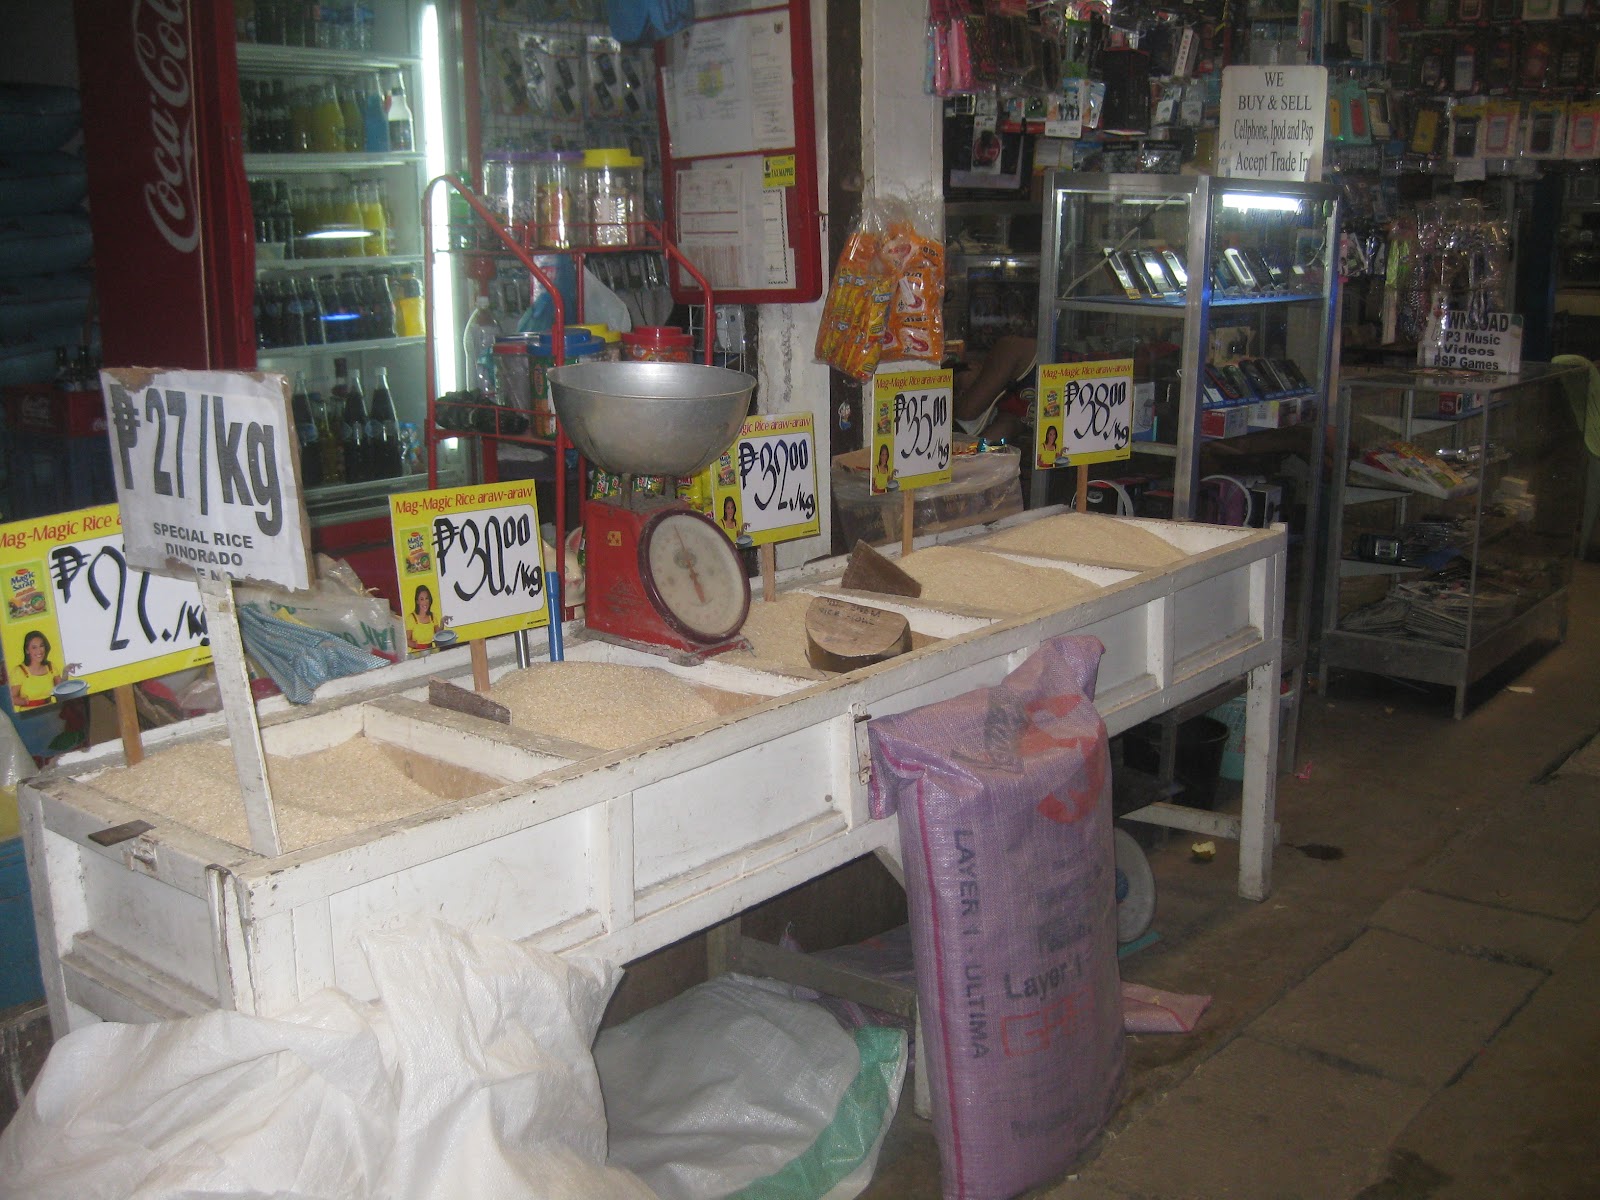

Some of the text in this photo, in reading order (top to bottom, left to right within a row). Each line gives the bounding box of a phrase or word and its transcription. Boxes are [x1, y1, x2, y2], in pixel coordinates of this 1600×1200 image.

[1264, 71, 1284, 87] WE
[1238, 95, 1312, 110] BUY & SELL
[133, 0, 201, 252] Coca-Col
[1234, 119, 1313, 146] Cellphone, Ipod and Psp
[1235, 151, 1268, 176] Accept
[1270, 151, 1297, 171] Trade
[1446, 331, 1501, 345] P3 Music
[1444, 344, 1495, 356] Videos
[1042, 364, 1132, 379] Mag-Magic Rice araw-araw
[1460, 357, 1499, 370] Games
[875, 377, 907, 391] Mag-Magic
[909, 375, 920, 386] Rice
[754, 421, 769, 432] Rice
[770, 417, 812, 431] araw-araw
[395, 487, 534, 516] Mag-Magic Rice araw-araw
[83, 515, 112, 532] Rice
[153, 522, 254, 549] SPECIAL RICE
[165, 543, 243, 566] DINORADO
[954, 829, 980, 917] LAYER
[1003, 961, 1069, 1001] Layer
[965, 964, 990, 1060] ULTIMA
